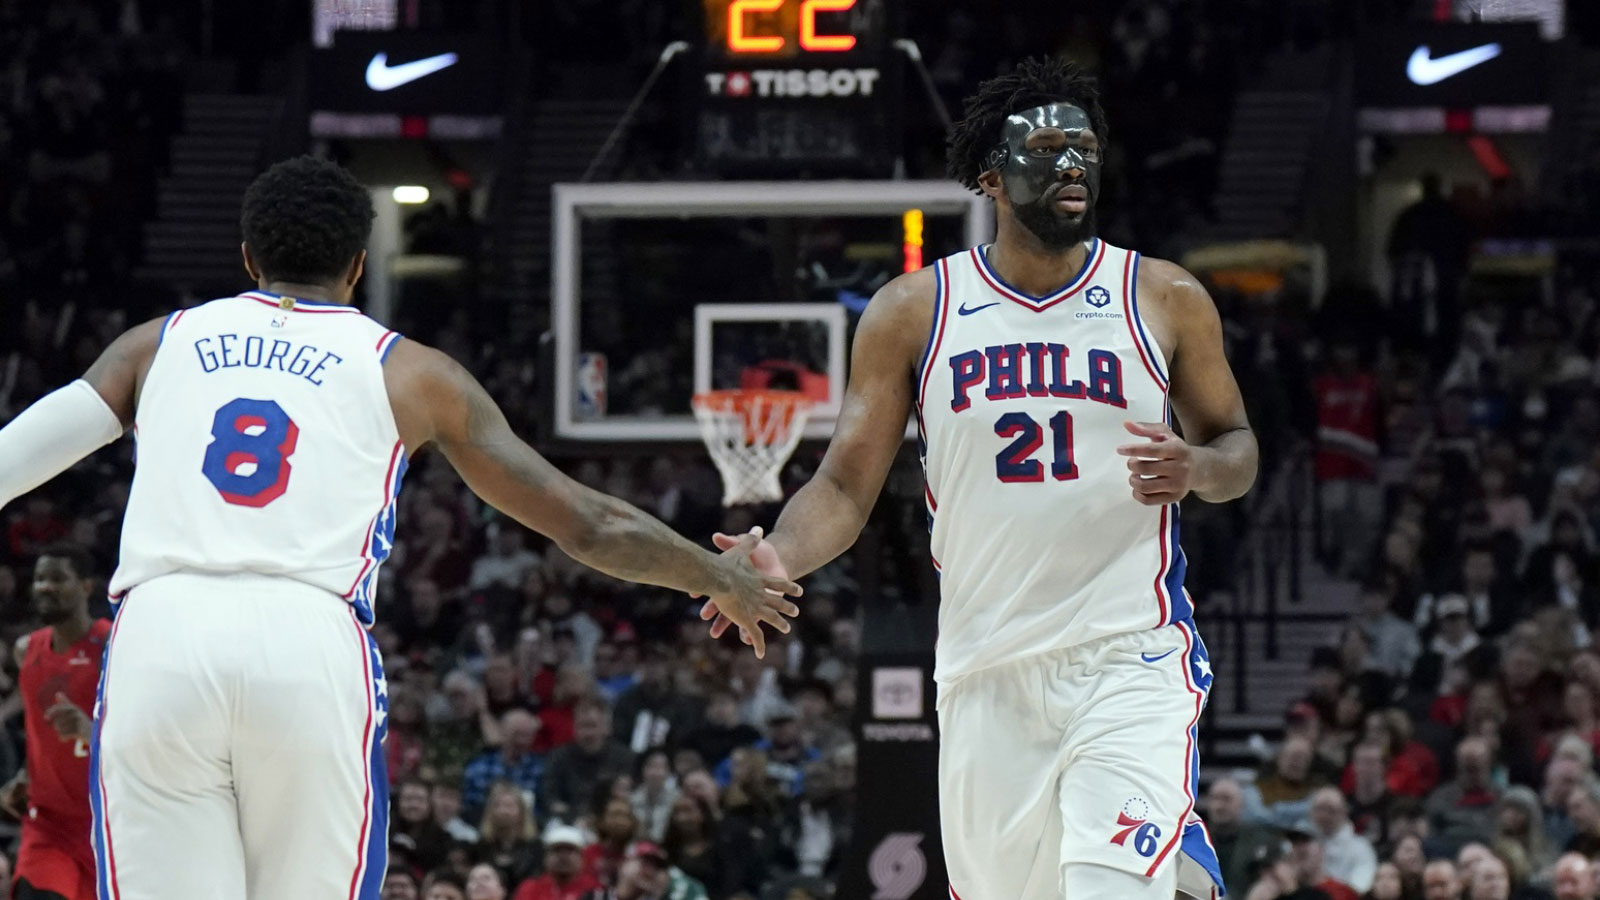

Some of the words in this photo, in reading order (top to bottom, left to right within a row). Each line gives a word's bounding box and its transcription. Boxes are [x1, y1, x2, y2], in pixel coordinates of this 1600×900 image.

[752, 69, 879, 96] TISSOT
[1075, 311, 1123, 319] crypto.com
[194, 334, 343, 386] GEORGE
[949, 342, 1128, 413] PHILA
[201, 397, 300, 508] 8
[994, 410, 1079, 483] 21
[1110, 811, 1161, 857] 76
